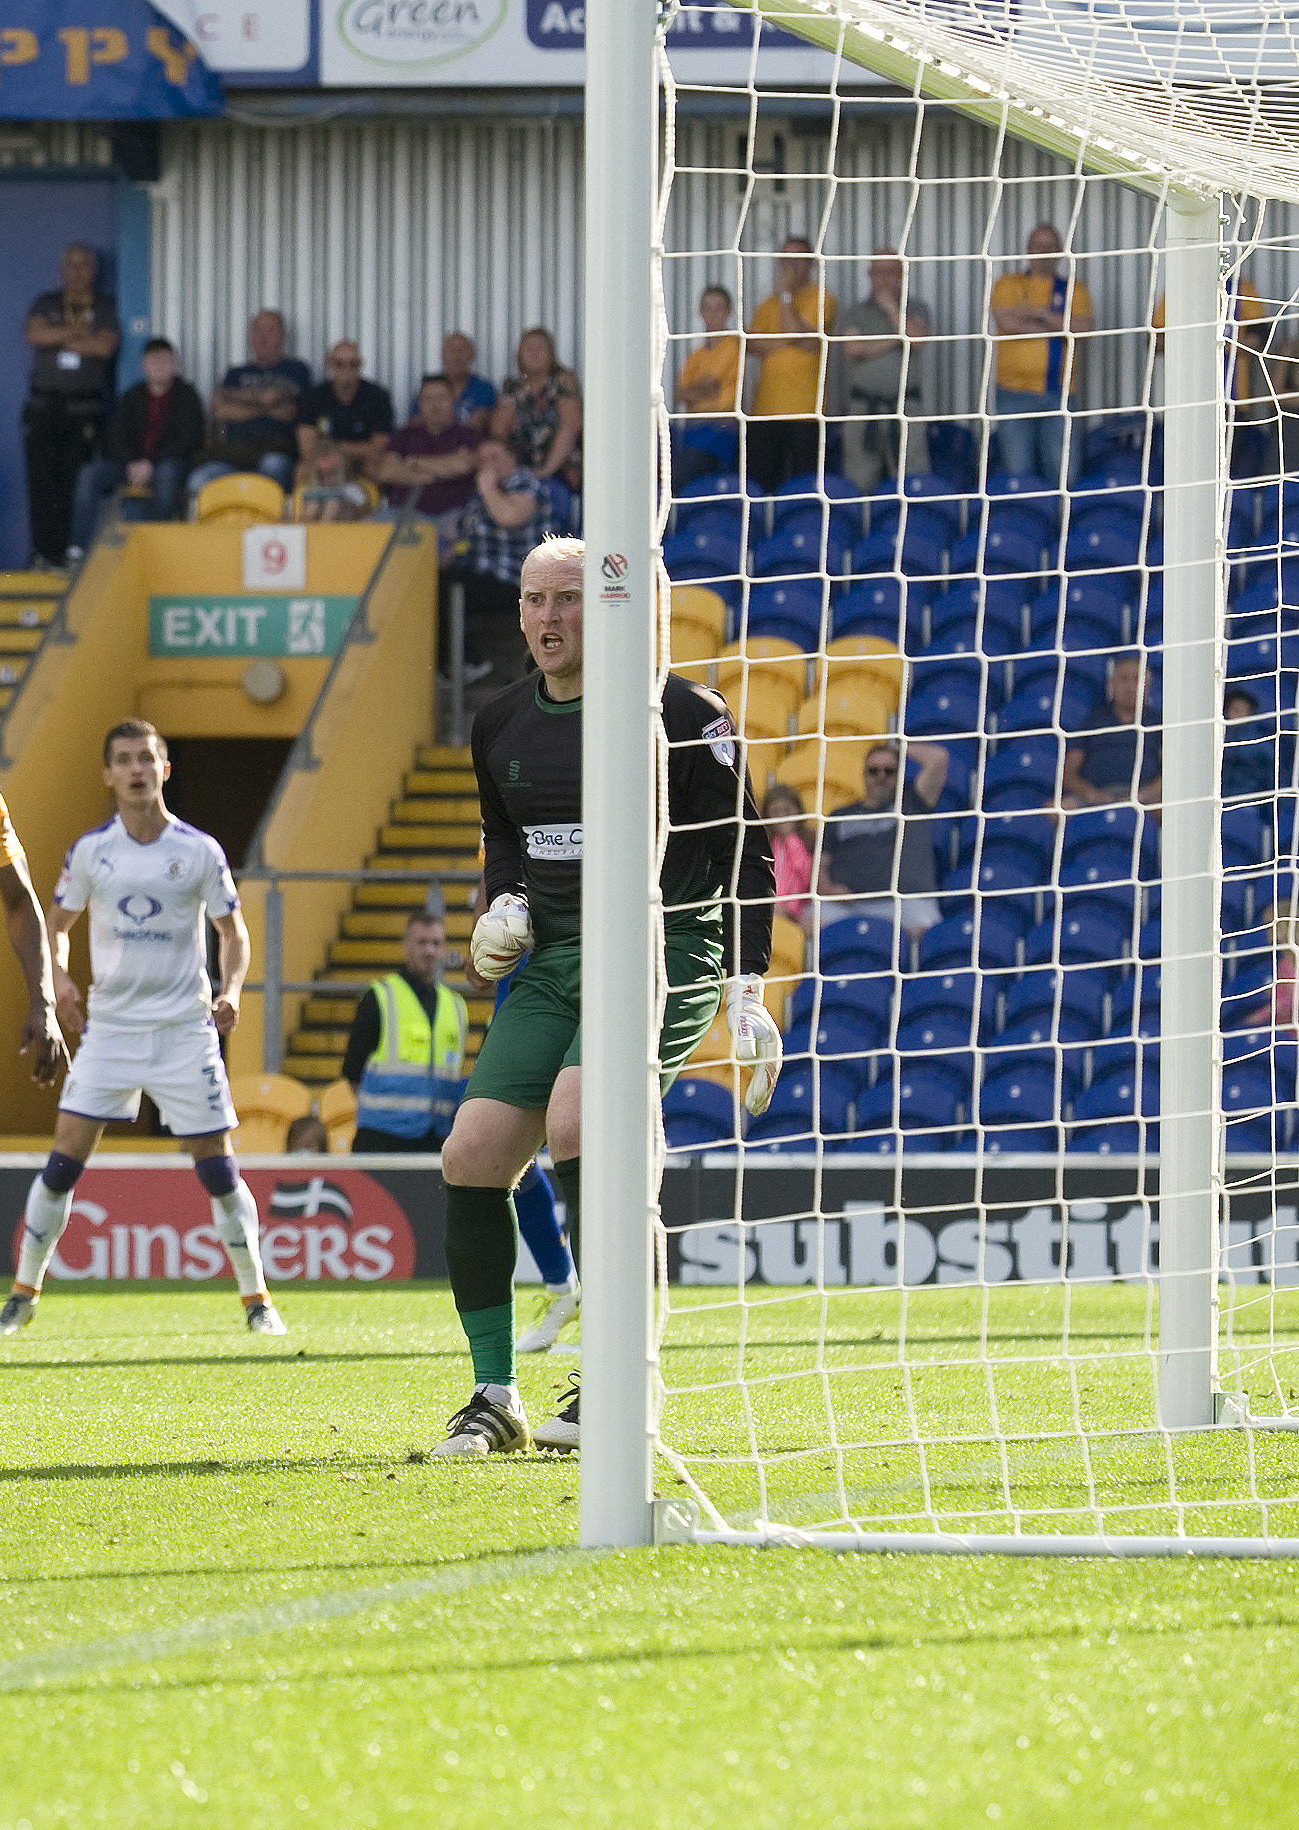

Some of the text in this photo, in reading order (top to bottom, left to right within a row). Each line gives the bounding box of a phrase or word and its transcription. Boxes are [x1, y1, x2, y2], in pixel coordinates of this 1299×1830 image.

[262, 540, 287, 575] 9
[163, 607, 267, 646] EXIT
[531, 830, 564, 846] One
